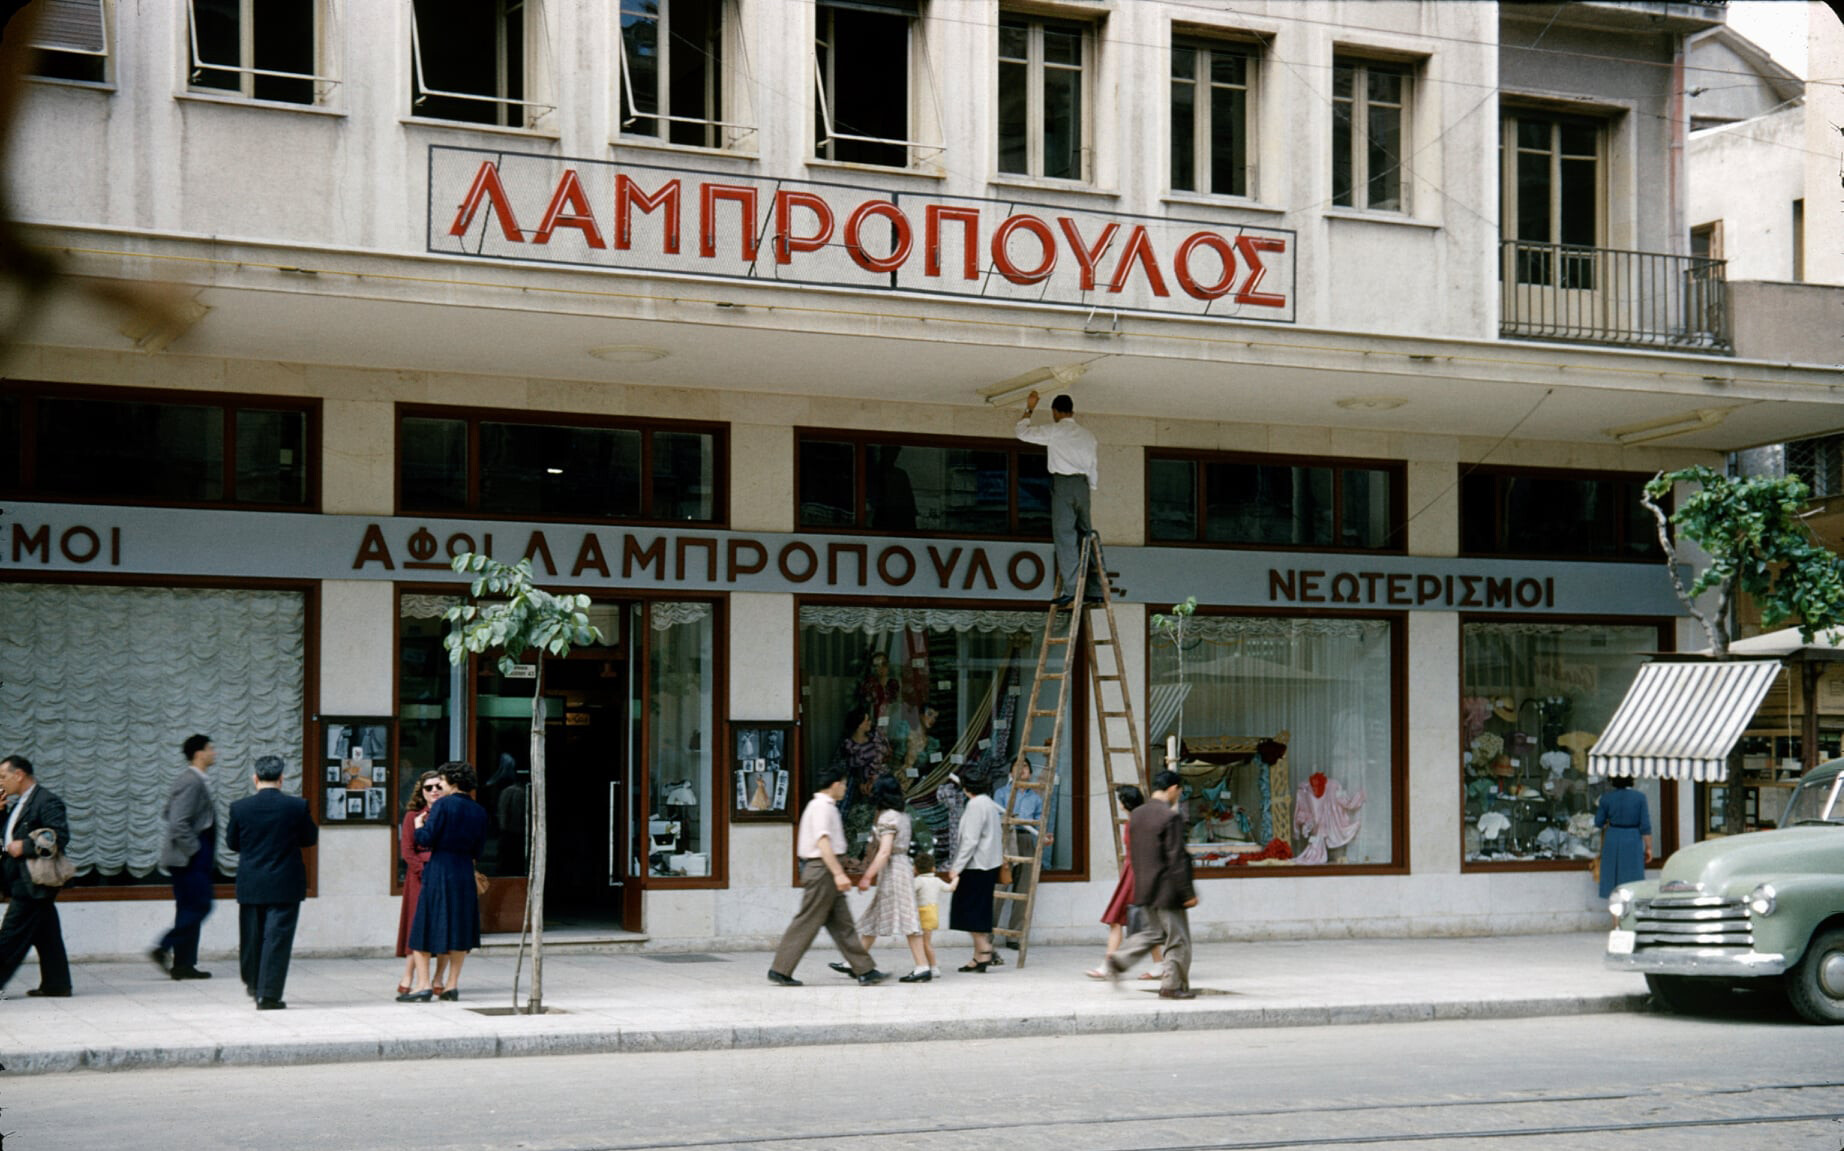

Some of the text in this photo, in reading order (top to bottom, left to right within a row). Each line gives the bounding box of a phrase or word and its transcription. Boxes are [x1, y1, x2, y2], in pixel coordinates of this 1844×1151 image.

[450, 162, 1287, 308] ΛΑΜΠΡΟΠΟΥΛΟΣ
[0, 523, 120, 566] ΜΟΙ
[522, 530, 1060, 592] ΛΑΜΠΡΟΠΟΥΛΟ
[1269, 568, 1554, 608] ΝΕΩΤΕΡΙΣΜΟΙ
